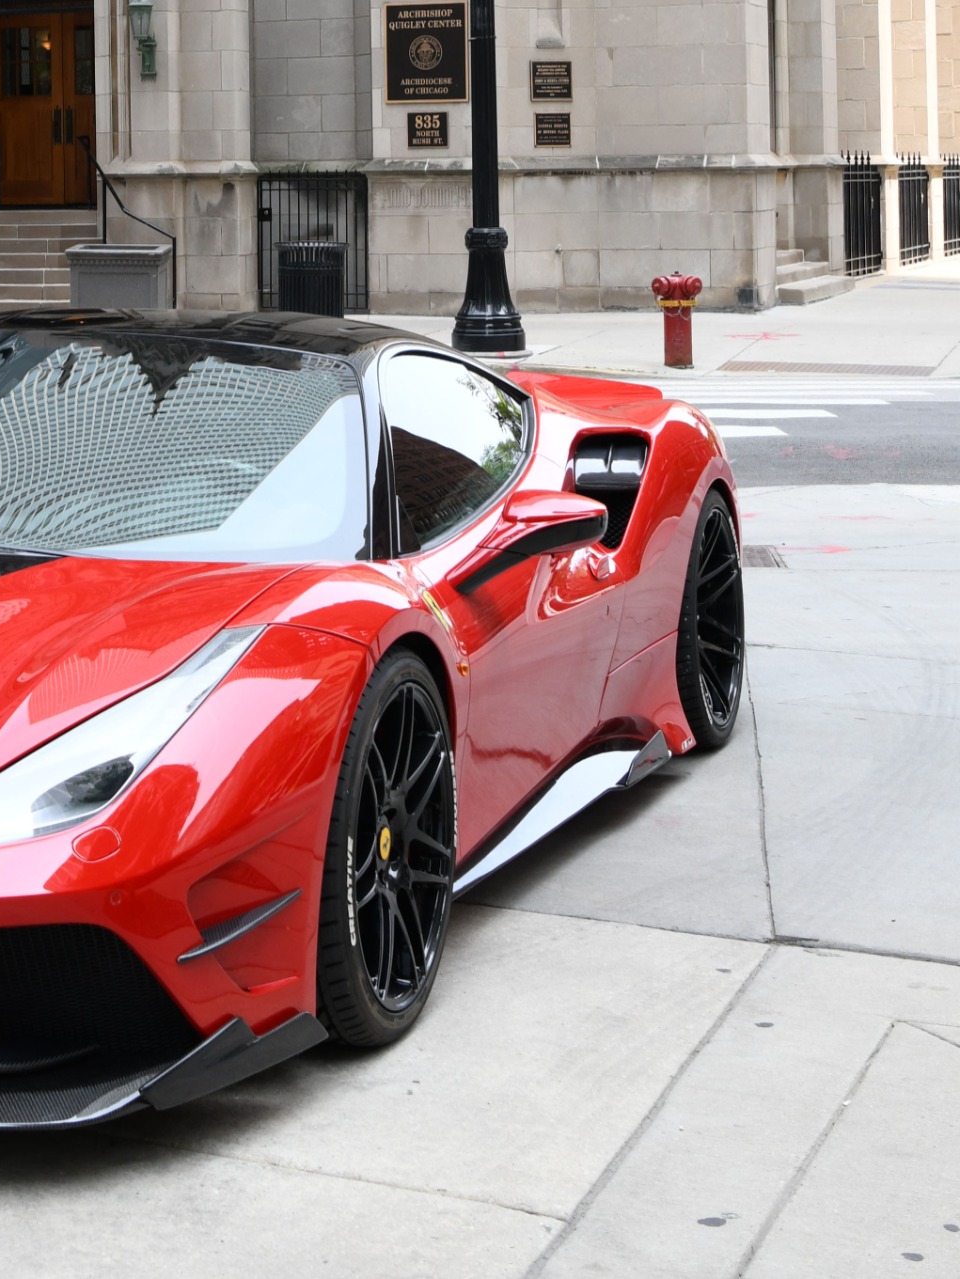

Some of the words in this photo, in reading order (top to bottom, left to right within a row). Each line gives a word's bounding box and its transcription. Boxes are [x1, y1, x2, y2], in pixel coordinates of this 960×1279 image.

[398, 9, 453, 18] ARCHBISHOP
[389, 21, 426, 30] QUIGLEY
[428, 19, 462, 28] CENTER
[415, 115, 440, 128] 835
[347, 836, 356, 946] CREATIVE
